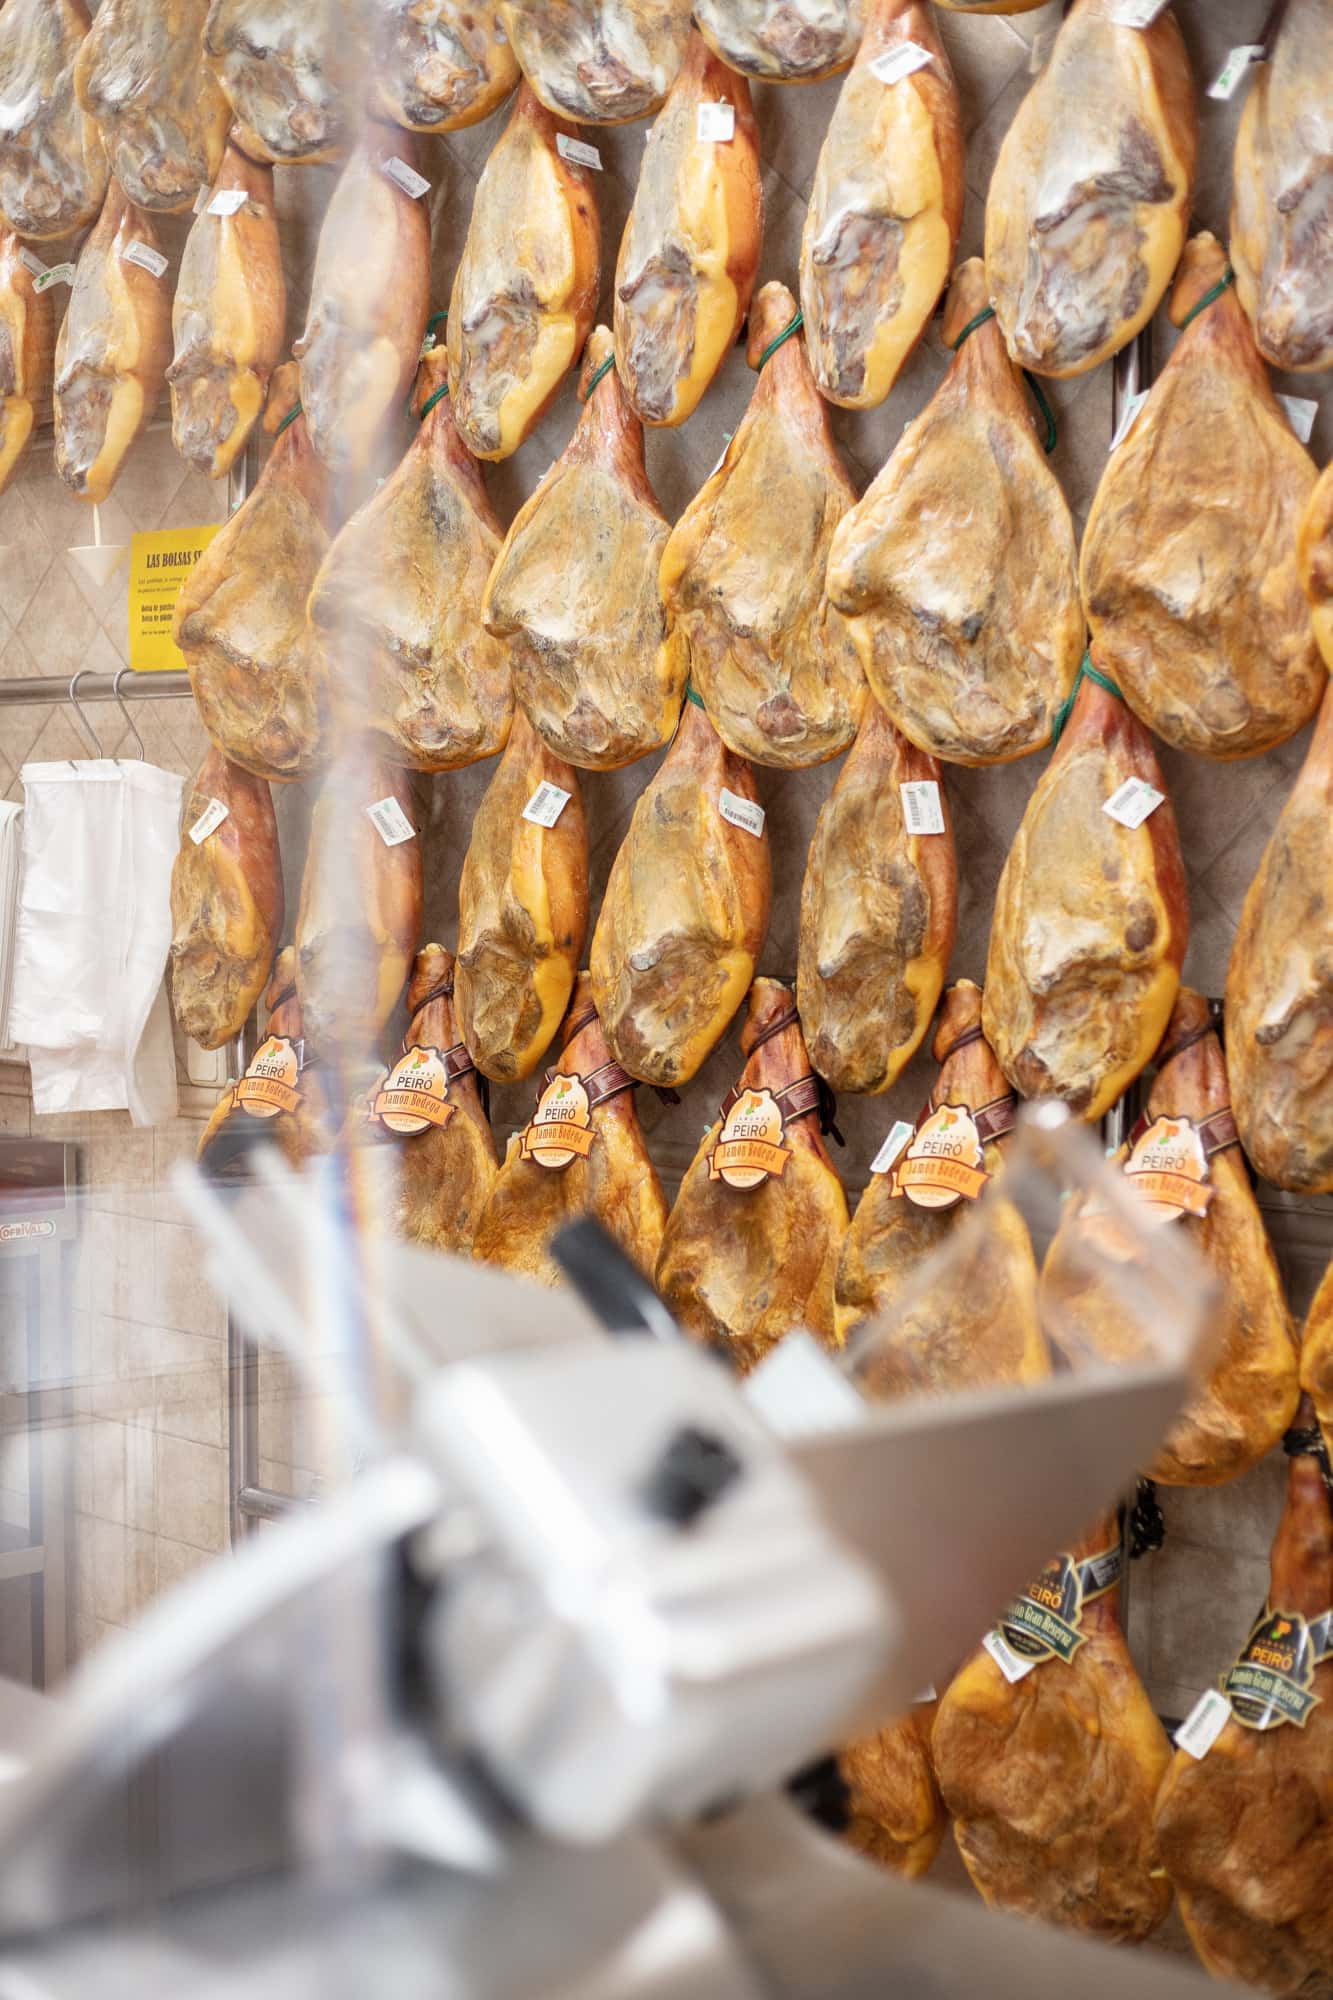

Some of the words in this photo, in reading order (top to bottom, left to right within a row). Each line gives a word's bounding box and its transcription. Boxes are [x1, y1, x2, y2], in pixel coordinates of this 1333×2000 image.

[146, 554, 160, 569] LAS
[162, 551, 192, 568] BOLSAS
[410, 1093, 441, 1113] Bodega
[544, 1105, 576, 1120] PEIRÓ
[733, 1121, 768, 1137] PEIRÓ
[922, 1140, 963, 1156] PEIRÓ
[1142, 1153, 1187, 1170] PEIRÓ
[1027, 1584, 1062, 1608] EIRÓ
[1024, 1605, 1044, 1627] Gran
[1041, 1615, 1072, 1648] Reserva
[1249, 1646, 1294, 1671] PEIRÓ
[1252, 1671, 1274, 1692] Gran
[1271, 1678, 1306, 1711] Reserva
